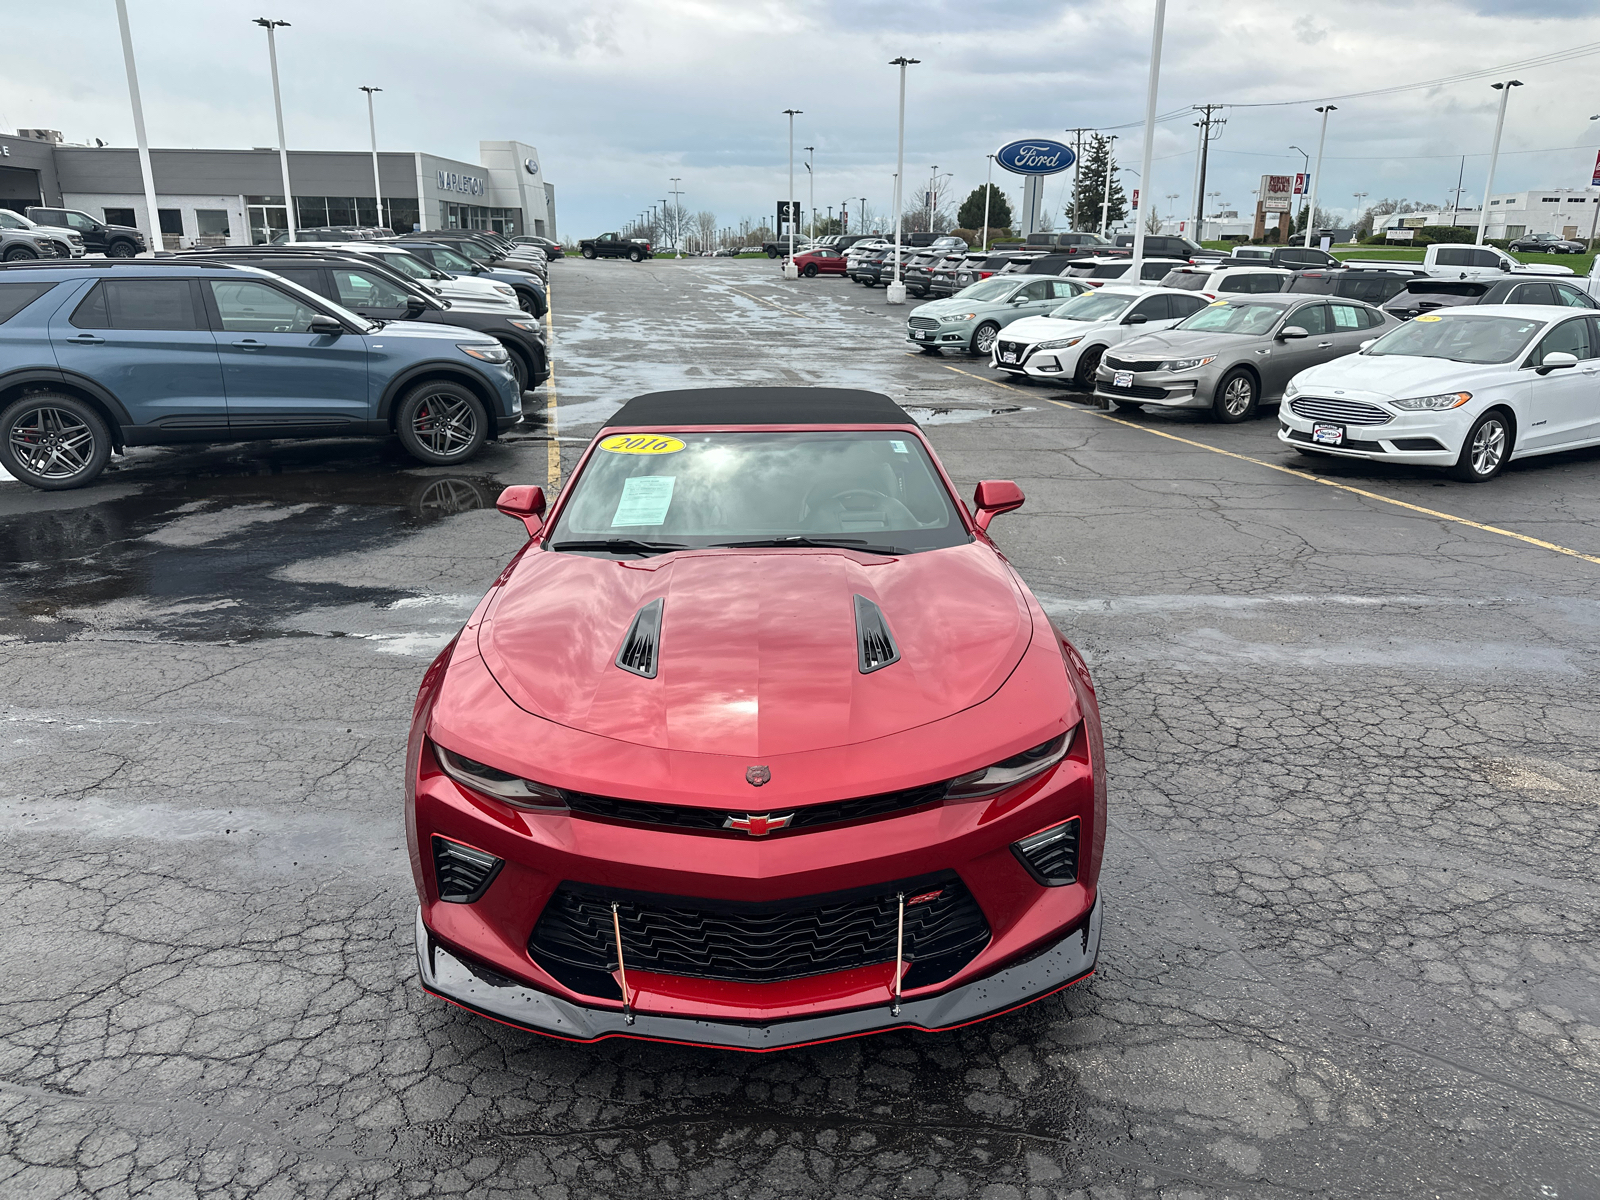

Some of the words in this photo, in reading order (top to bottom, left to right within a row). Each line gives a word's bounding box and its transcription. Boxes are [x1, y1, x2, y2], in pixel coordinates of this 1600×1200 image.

[1014, 145, 1061, 167] Ford
[437, 169, 484, 196] NAPLETON
[610, 437, 674, 451] 2016
